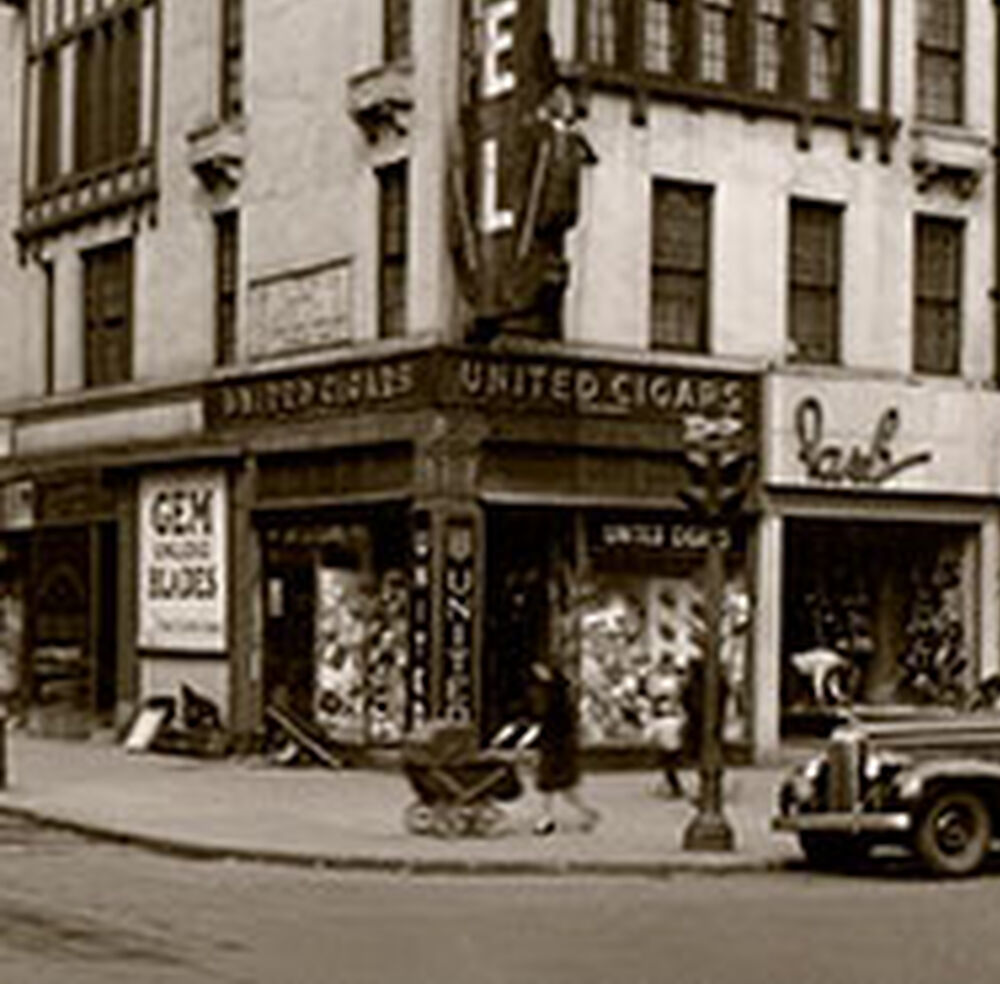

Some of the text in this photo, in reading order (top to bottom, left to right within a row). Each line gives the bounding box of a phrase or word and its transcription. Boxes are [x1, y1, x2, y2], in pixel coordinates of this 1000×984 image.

[460, 361, 743, 410] UNITED CIGARS
[152, 490, 214, 536] GEM
